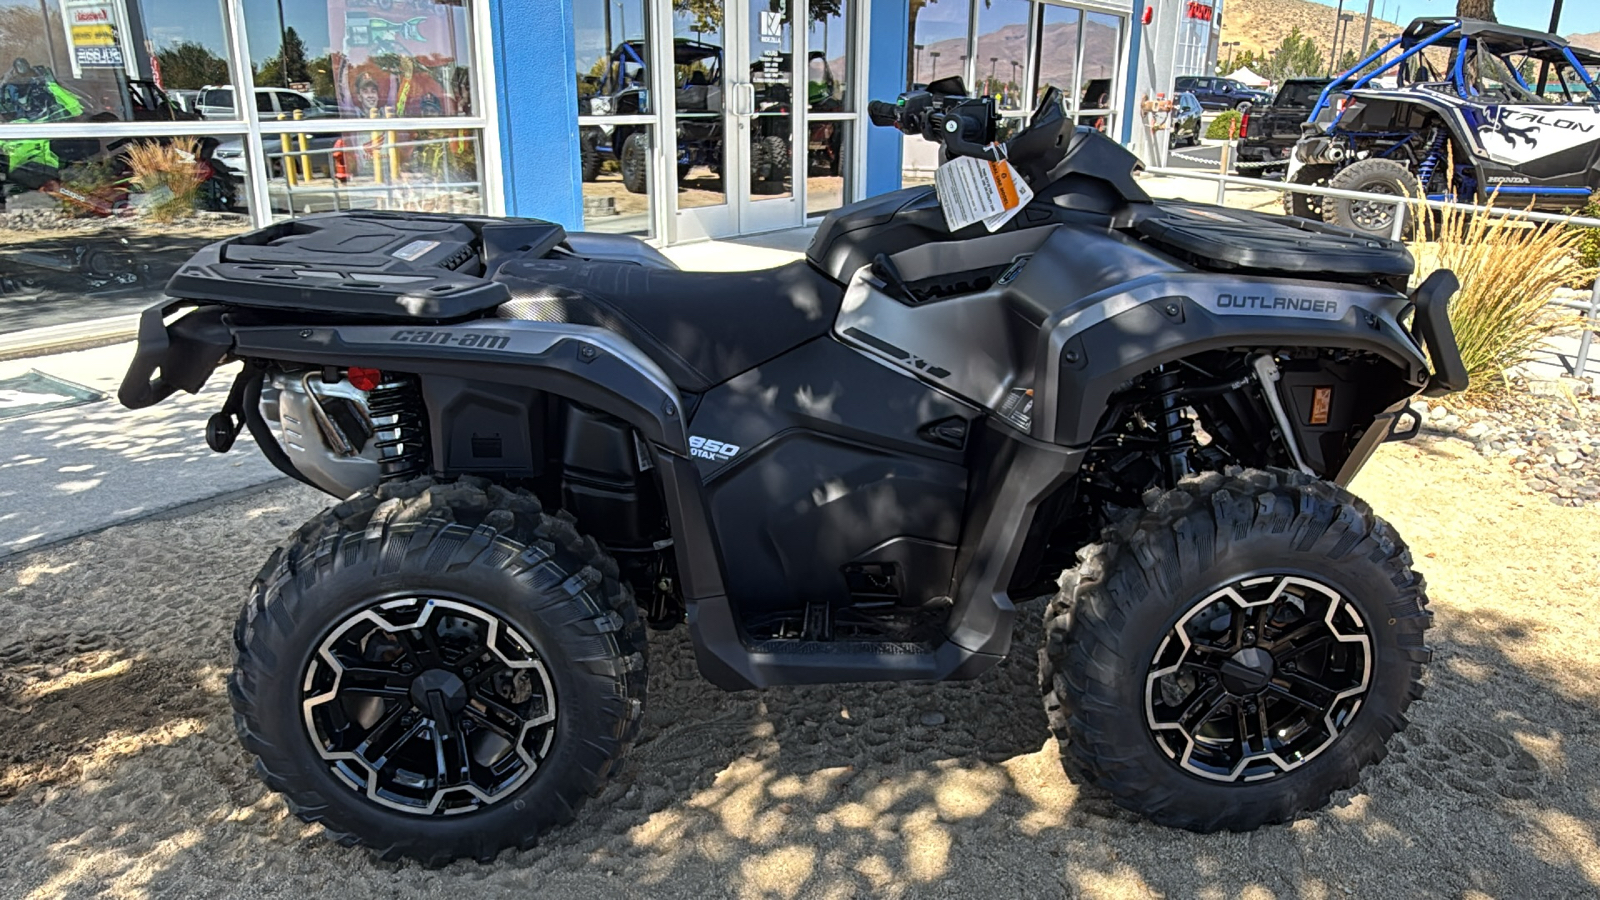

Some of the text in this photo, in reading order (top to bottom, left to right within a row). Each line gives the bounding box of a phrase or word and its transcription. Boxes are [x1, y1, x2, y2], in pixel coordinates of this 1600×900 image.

[1502, 110, 1595, 133] TALON
[1487, 176, 1531, 184] HONDA
[1216, 293, 1338, 313] OUTLANDER
[688, 435, 740, 457] 850
[690, 447, 716, 461] OTAX
